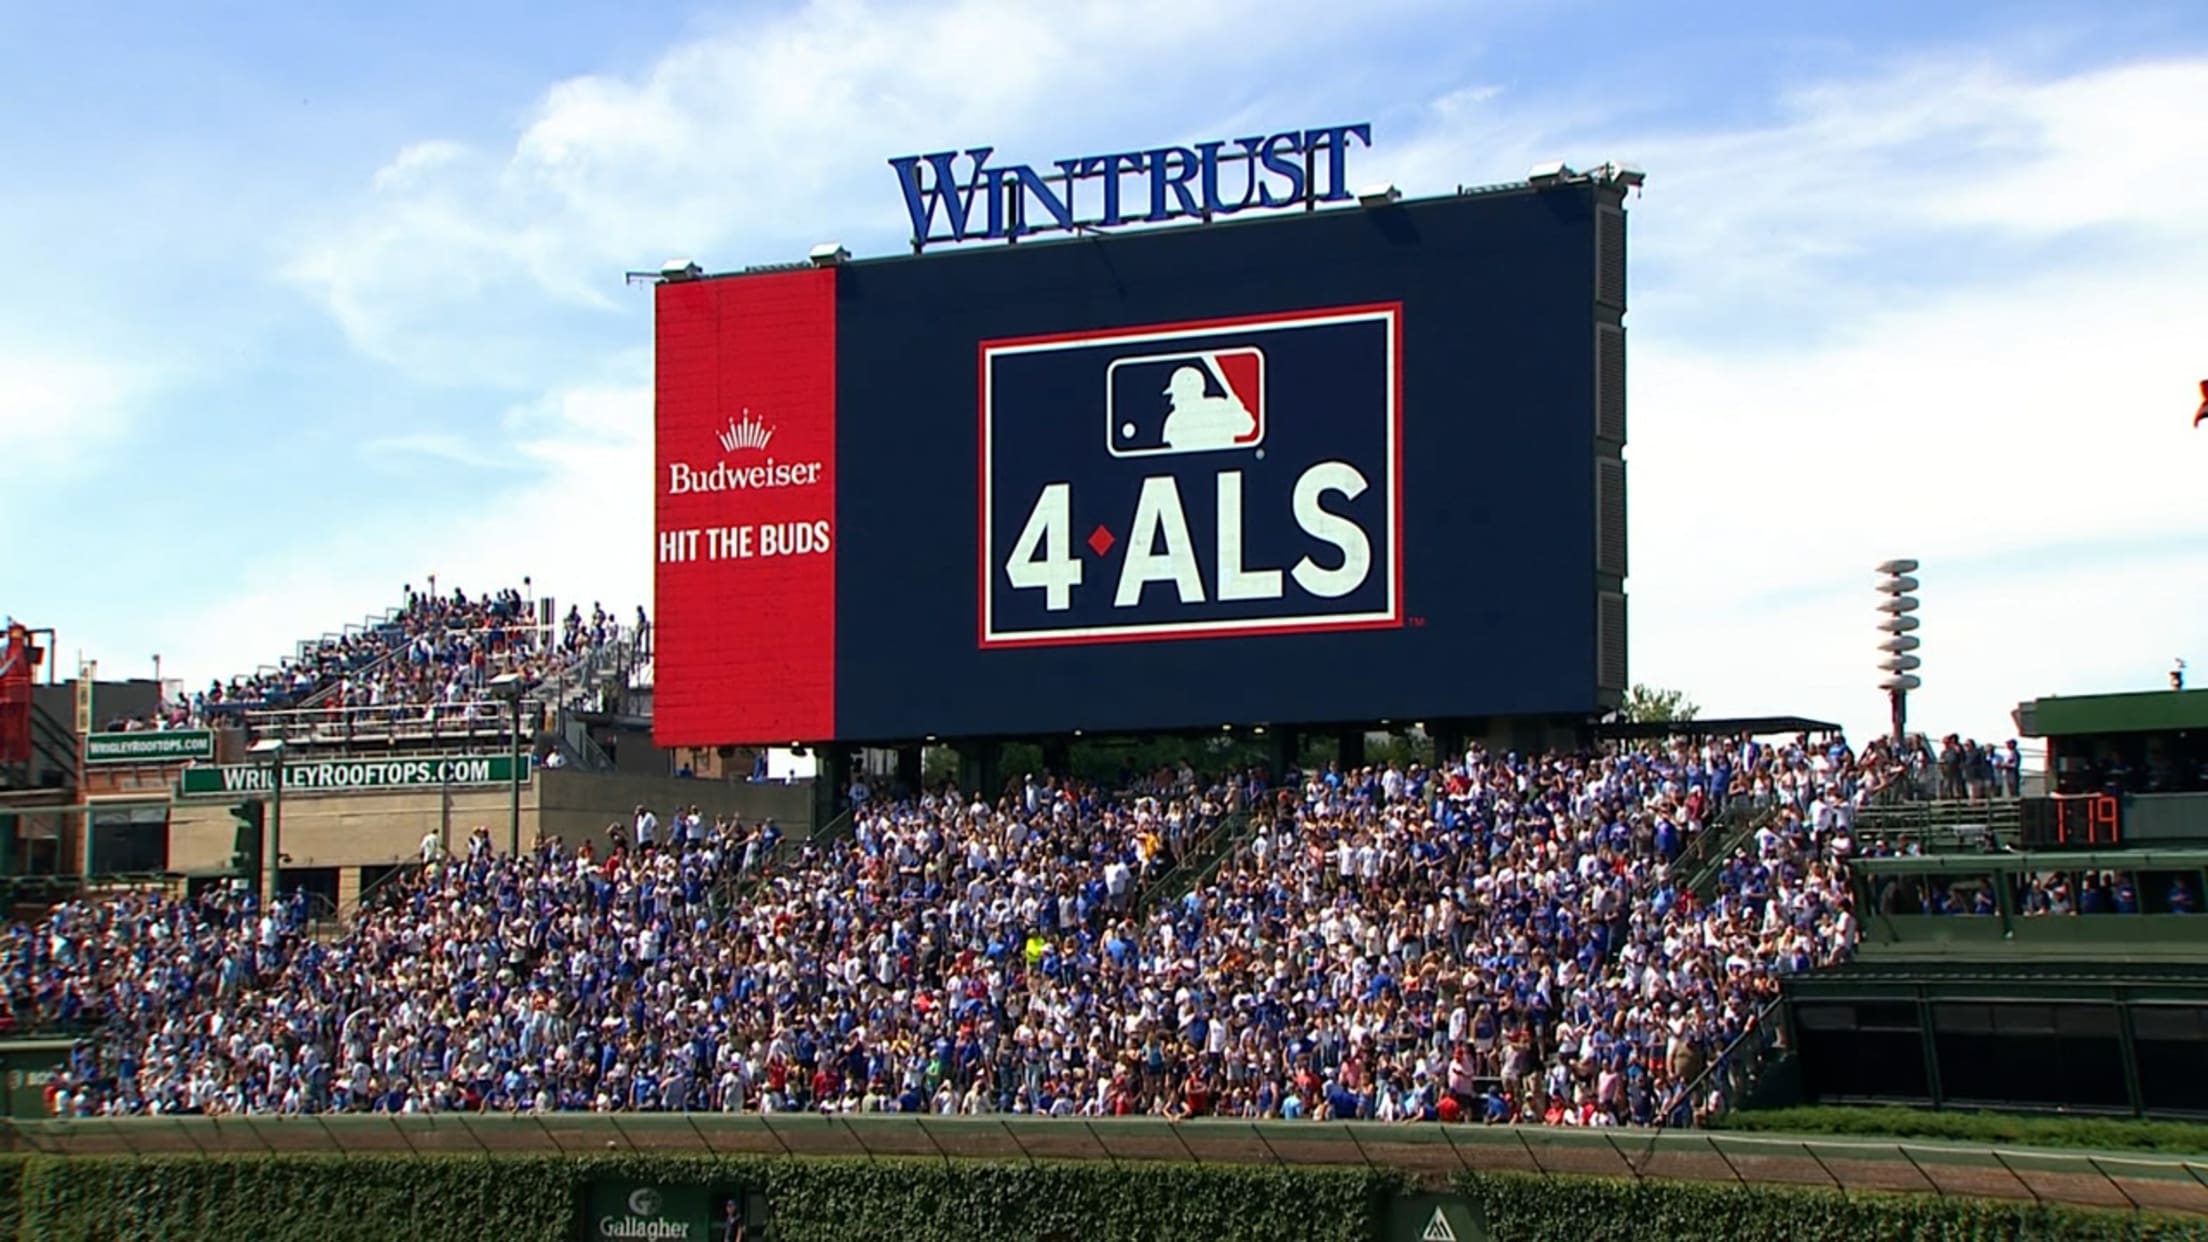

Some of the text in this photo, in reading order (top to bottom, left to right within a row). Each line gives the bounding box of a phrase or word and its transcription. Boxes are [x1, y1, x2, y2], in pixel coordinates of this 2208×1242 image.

[888, 123, 1371, 244] WINTRUST
[669, 457, 821, 494] Budweiser
[660, 520, 830, 563] HIT THE BUDS
[600, 1216, 690, 1241] Gallagher
